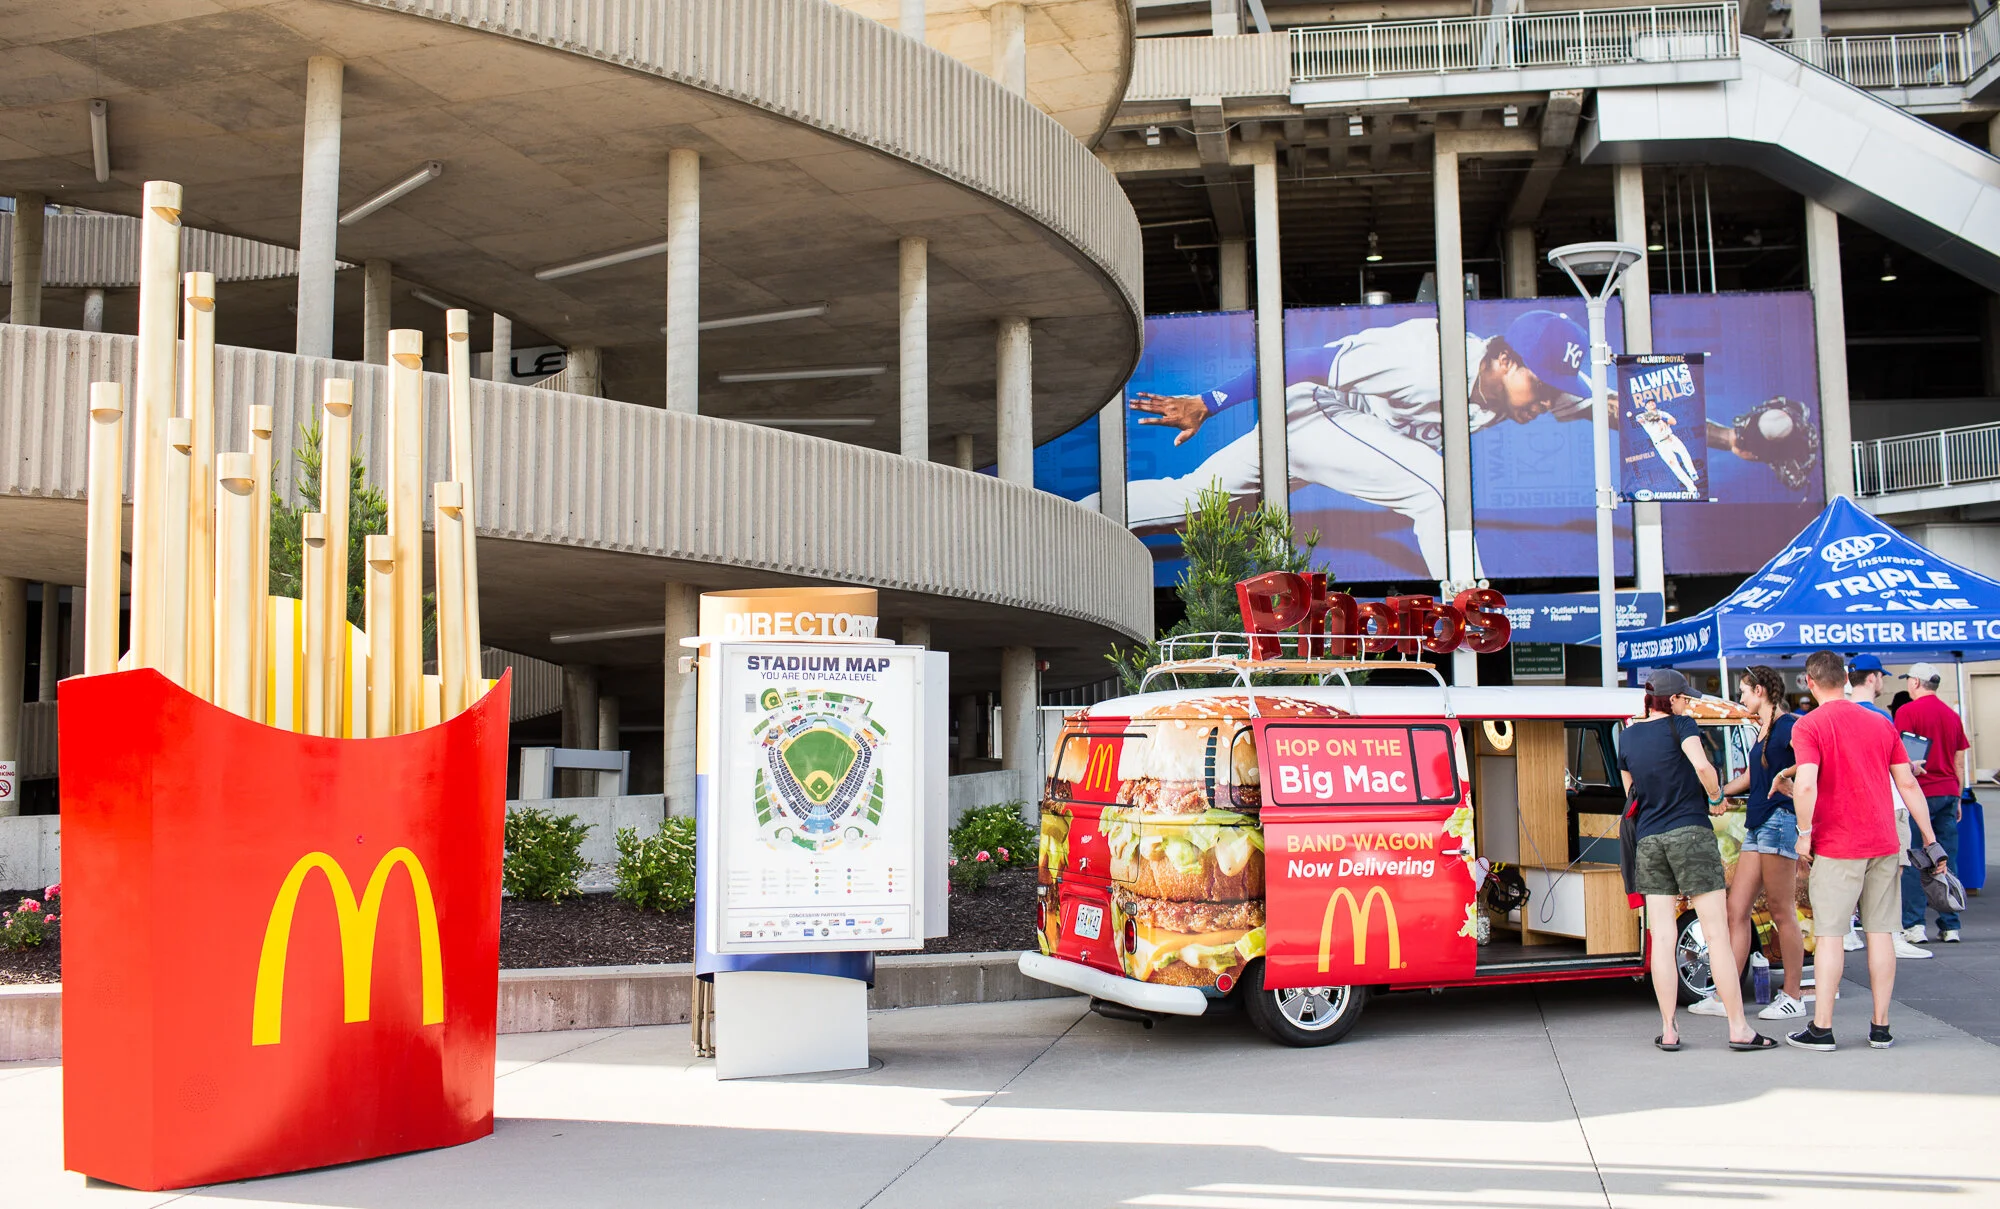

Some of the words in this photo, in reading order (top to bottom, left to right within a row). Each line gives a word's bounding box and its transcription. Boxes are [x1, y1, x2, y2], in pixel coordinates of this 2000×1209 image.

[1629, 363, 1689, 394] ALWAYS
[1654, 491, 1681, 500] KANSAS
[1824, 537, 1873, 561] AAA
[1857, 555, 1925, 570] Insurance
[1815, 568, 1961, 600] TRIPLE
[1879, 590, 1896, 599] OF
[1898, 589, 1923, 598] THE
[1550, 606, 1578, 614] Outfield
[1579, 606, 1599, 614] Plaza
[1615, 605, 1627, 613] Up
[724, 612, 879, 638] DIRECTORY
[1746, 623, 1773, 641] AAA
[1800, 622, 1906, 645] REGISTER
[1912, 620, 1968, 643] HERE
[1631, 640, 1658, 660] REGISTER
[1658, 637, 1673, 657] HERE
[747, 655, 839, 672] STADIUM
[845, 657, 891, 673] MAP
[761, 671, 780, 680] YOU
[781, 672, 800, 680] ARE
[802, 672, 816, 681] ON
[818, 672, 848, 681] PLAZA
[849, 673, 877, 682] LEVEL
[1275, 738, 1321, 757] HOP
[1325, 738, 1356, 757] ON
[1361, 738, 1402, 757] THE
[1278, 764, 1334, 799] Big
[1342, 764, 1408, 793] Mac
[1286, 834, 1347, 853] BAND
[1352, 832, 1434, 852] WAGON
[1287, 859, 1334, 878] Now
[1338, 856, 1436, 878] Delivering
